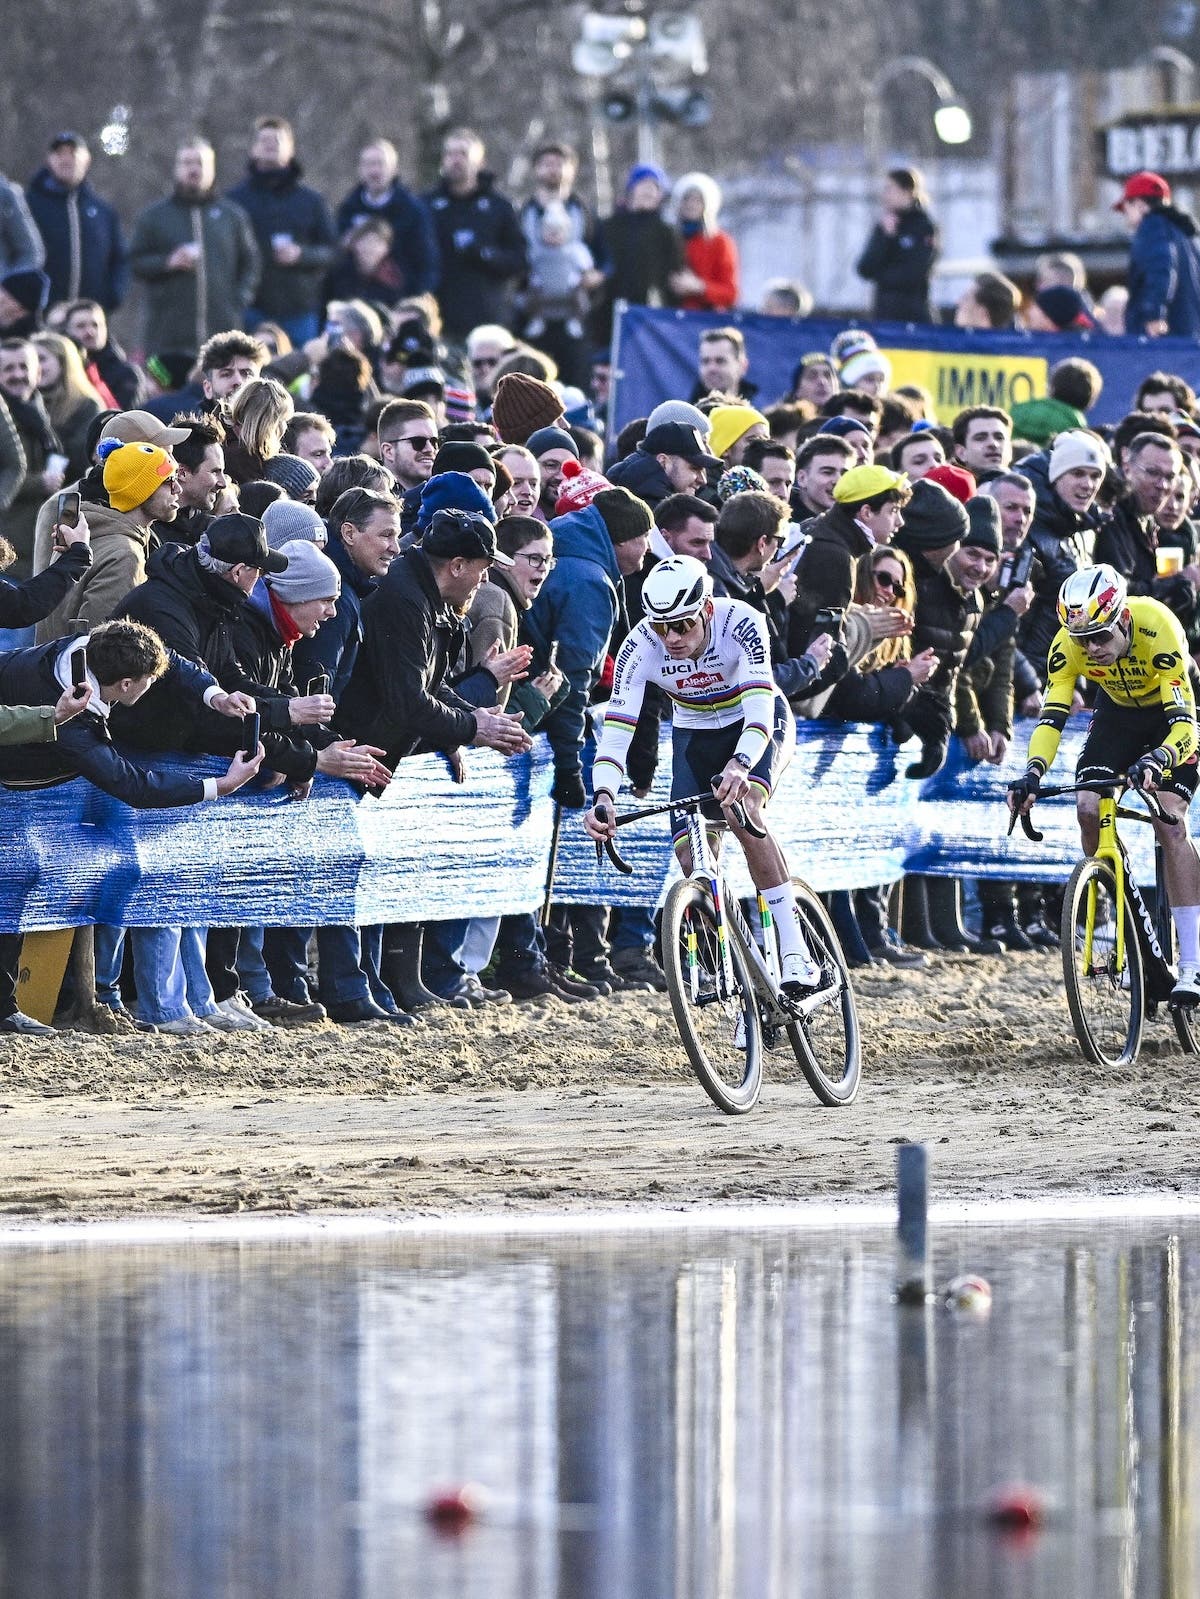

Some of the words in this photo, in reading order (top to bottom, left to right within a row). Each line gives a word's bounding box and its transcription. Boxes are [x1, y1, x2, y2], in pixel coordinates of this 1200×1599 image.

[937, 366, 1034, 405] IMMO
[733, 616, 767, 665] Alpecin
[614, 638, 638, 695] deceuninck
[667, 664, 692, 675] UCI
[682, 673, 718, 687] Alpecin
